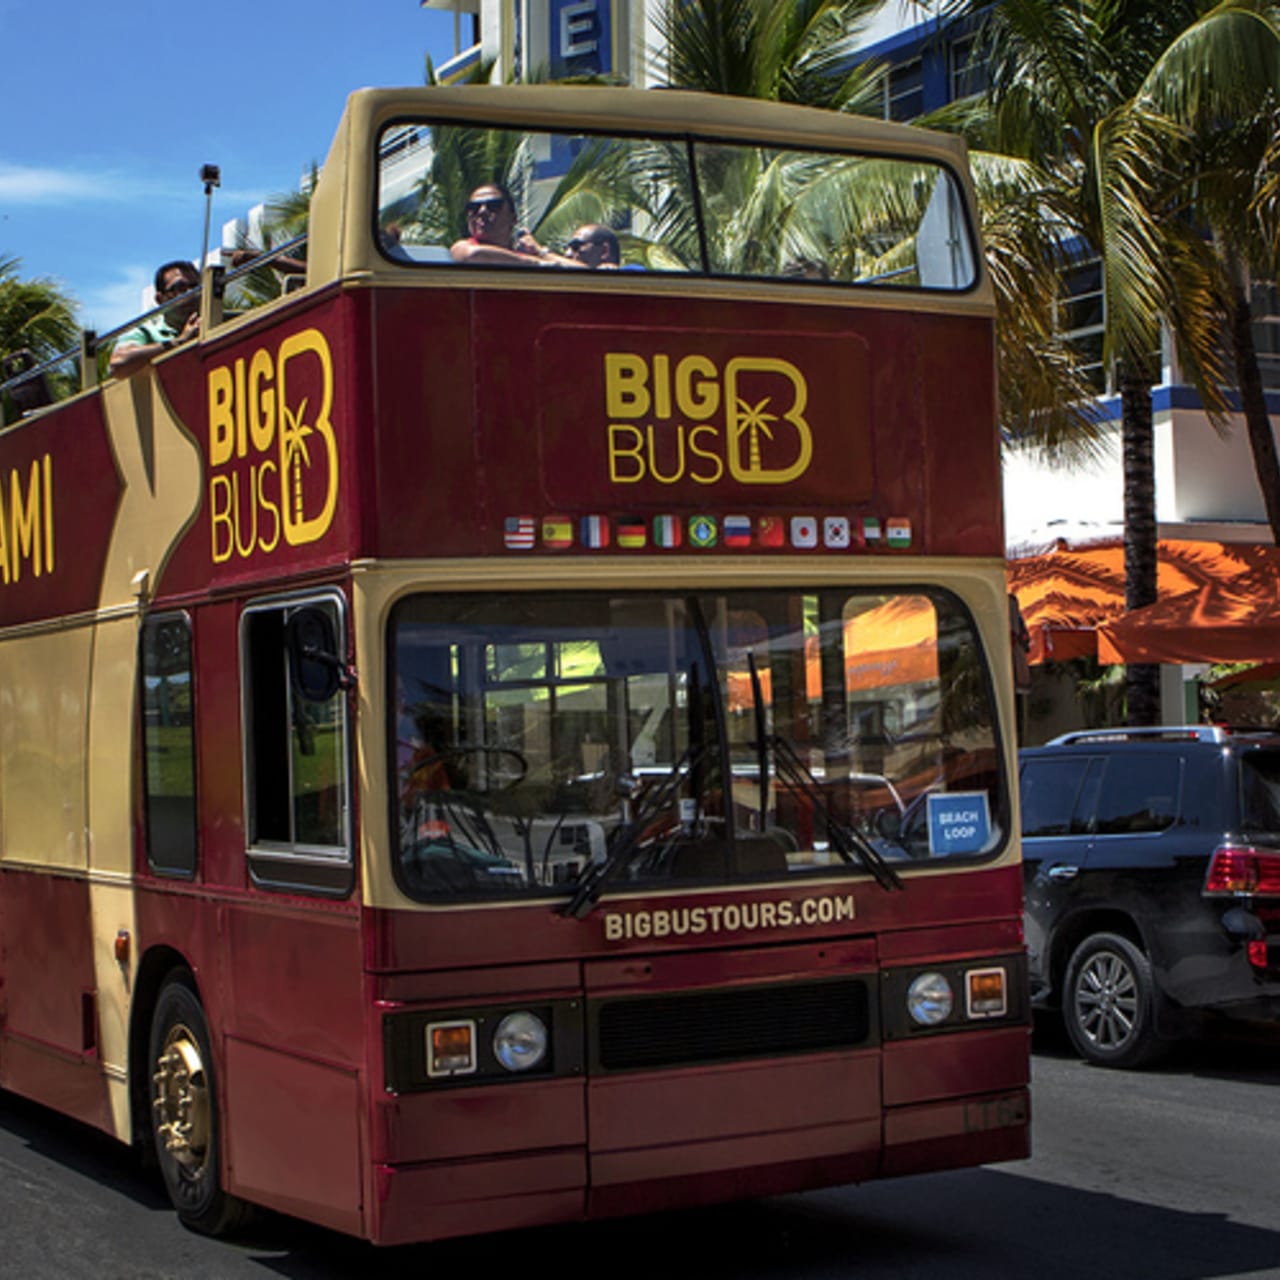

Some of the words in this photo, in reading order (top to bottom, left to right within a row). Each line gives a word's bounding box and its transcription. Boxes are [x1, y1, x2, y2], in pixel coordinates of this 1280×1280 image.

[208, 348, 275, 467] BIG
[605, 353, 720, 420] BIG
[608, 424, 723, 483] BUS
[210, 459, 280, 563] BUS
[939, 811, 979, 825] BEACH
[944, 826, 976, 840] LOOP
[605, 895, 855, 940] BIGBUSTOURS.COM
